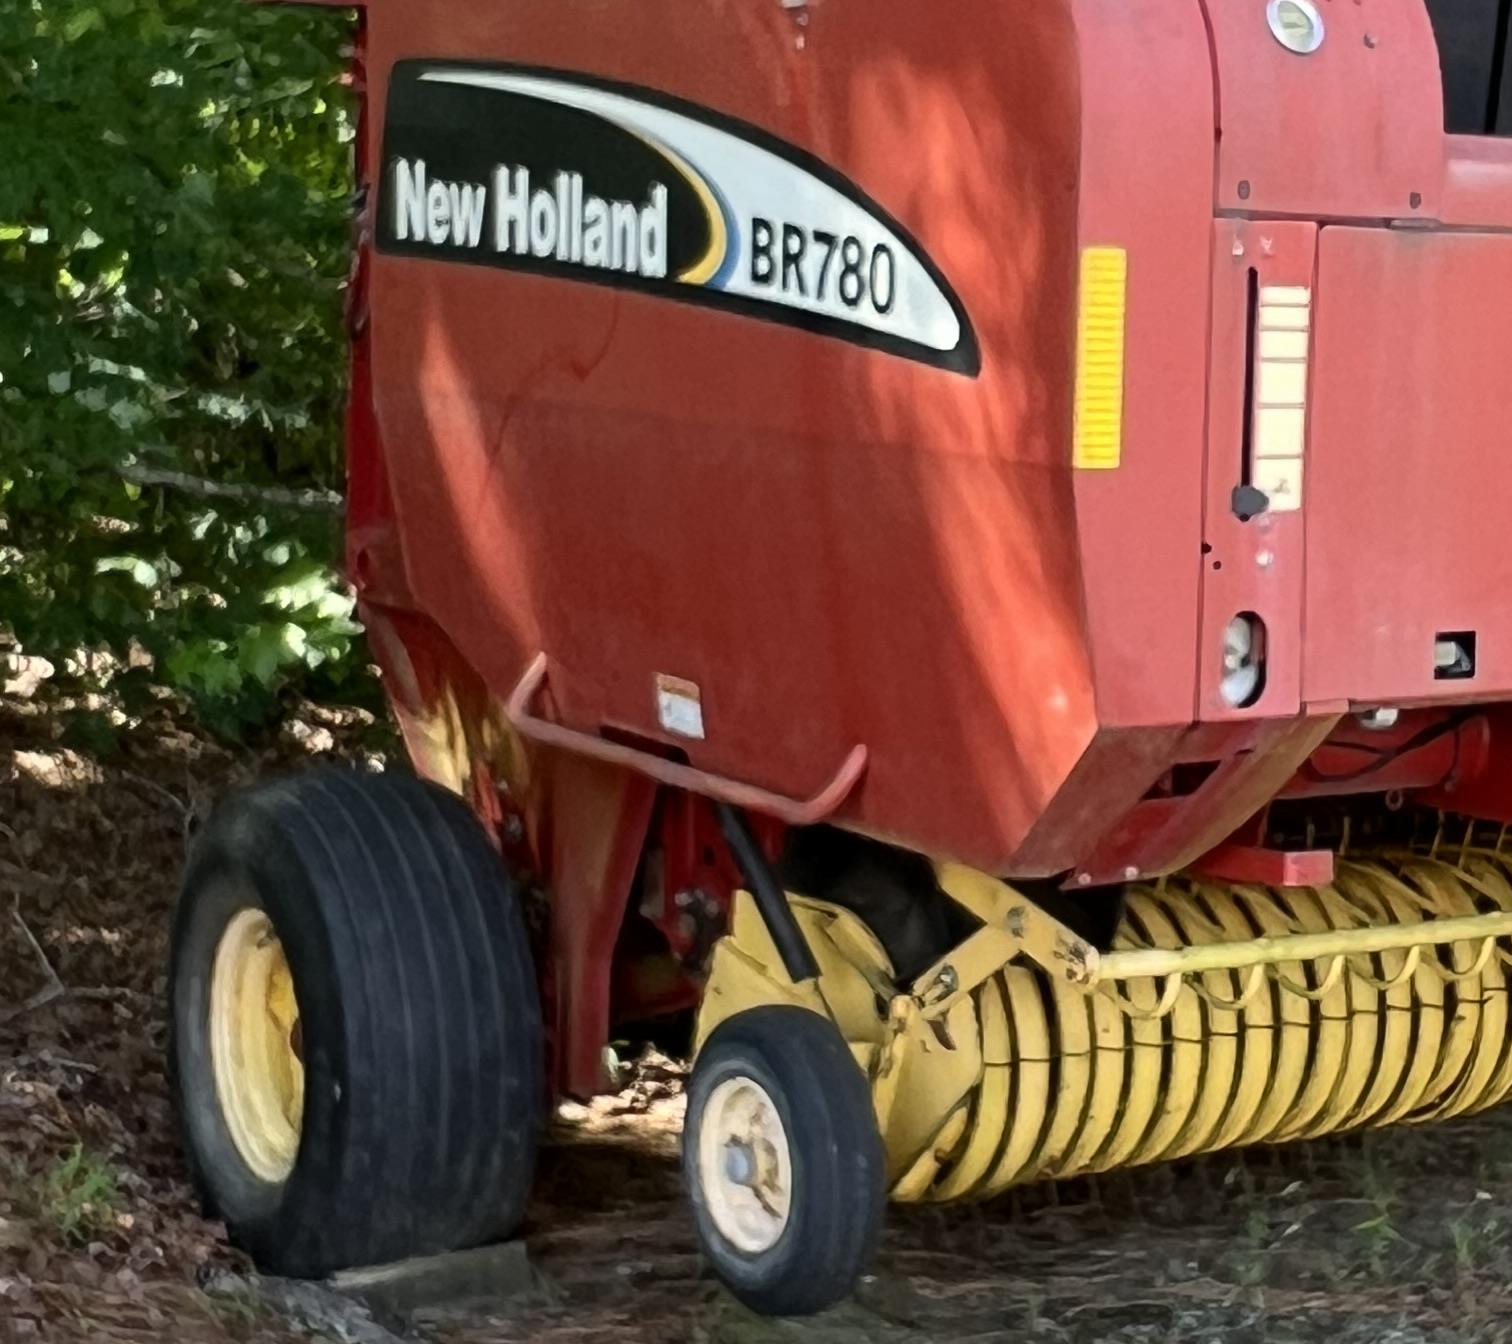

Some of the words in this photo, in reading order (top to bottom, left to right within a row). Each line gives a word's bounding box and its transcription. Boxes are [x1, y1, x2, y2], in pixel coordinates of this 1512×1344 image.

[395, 157, 487, 248] New
[494, 161, 668, 279] Holland
[751, 216, 897, 315] BR780
